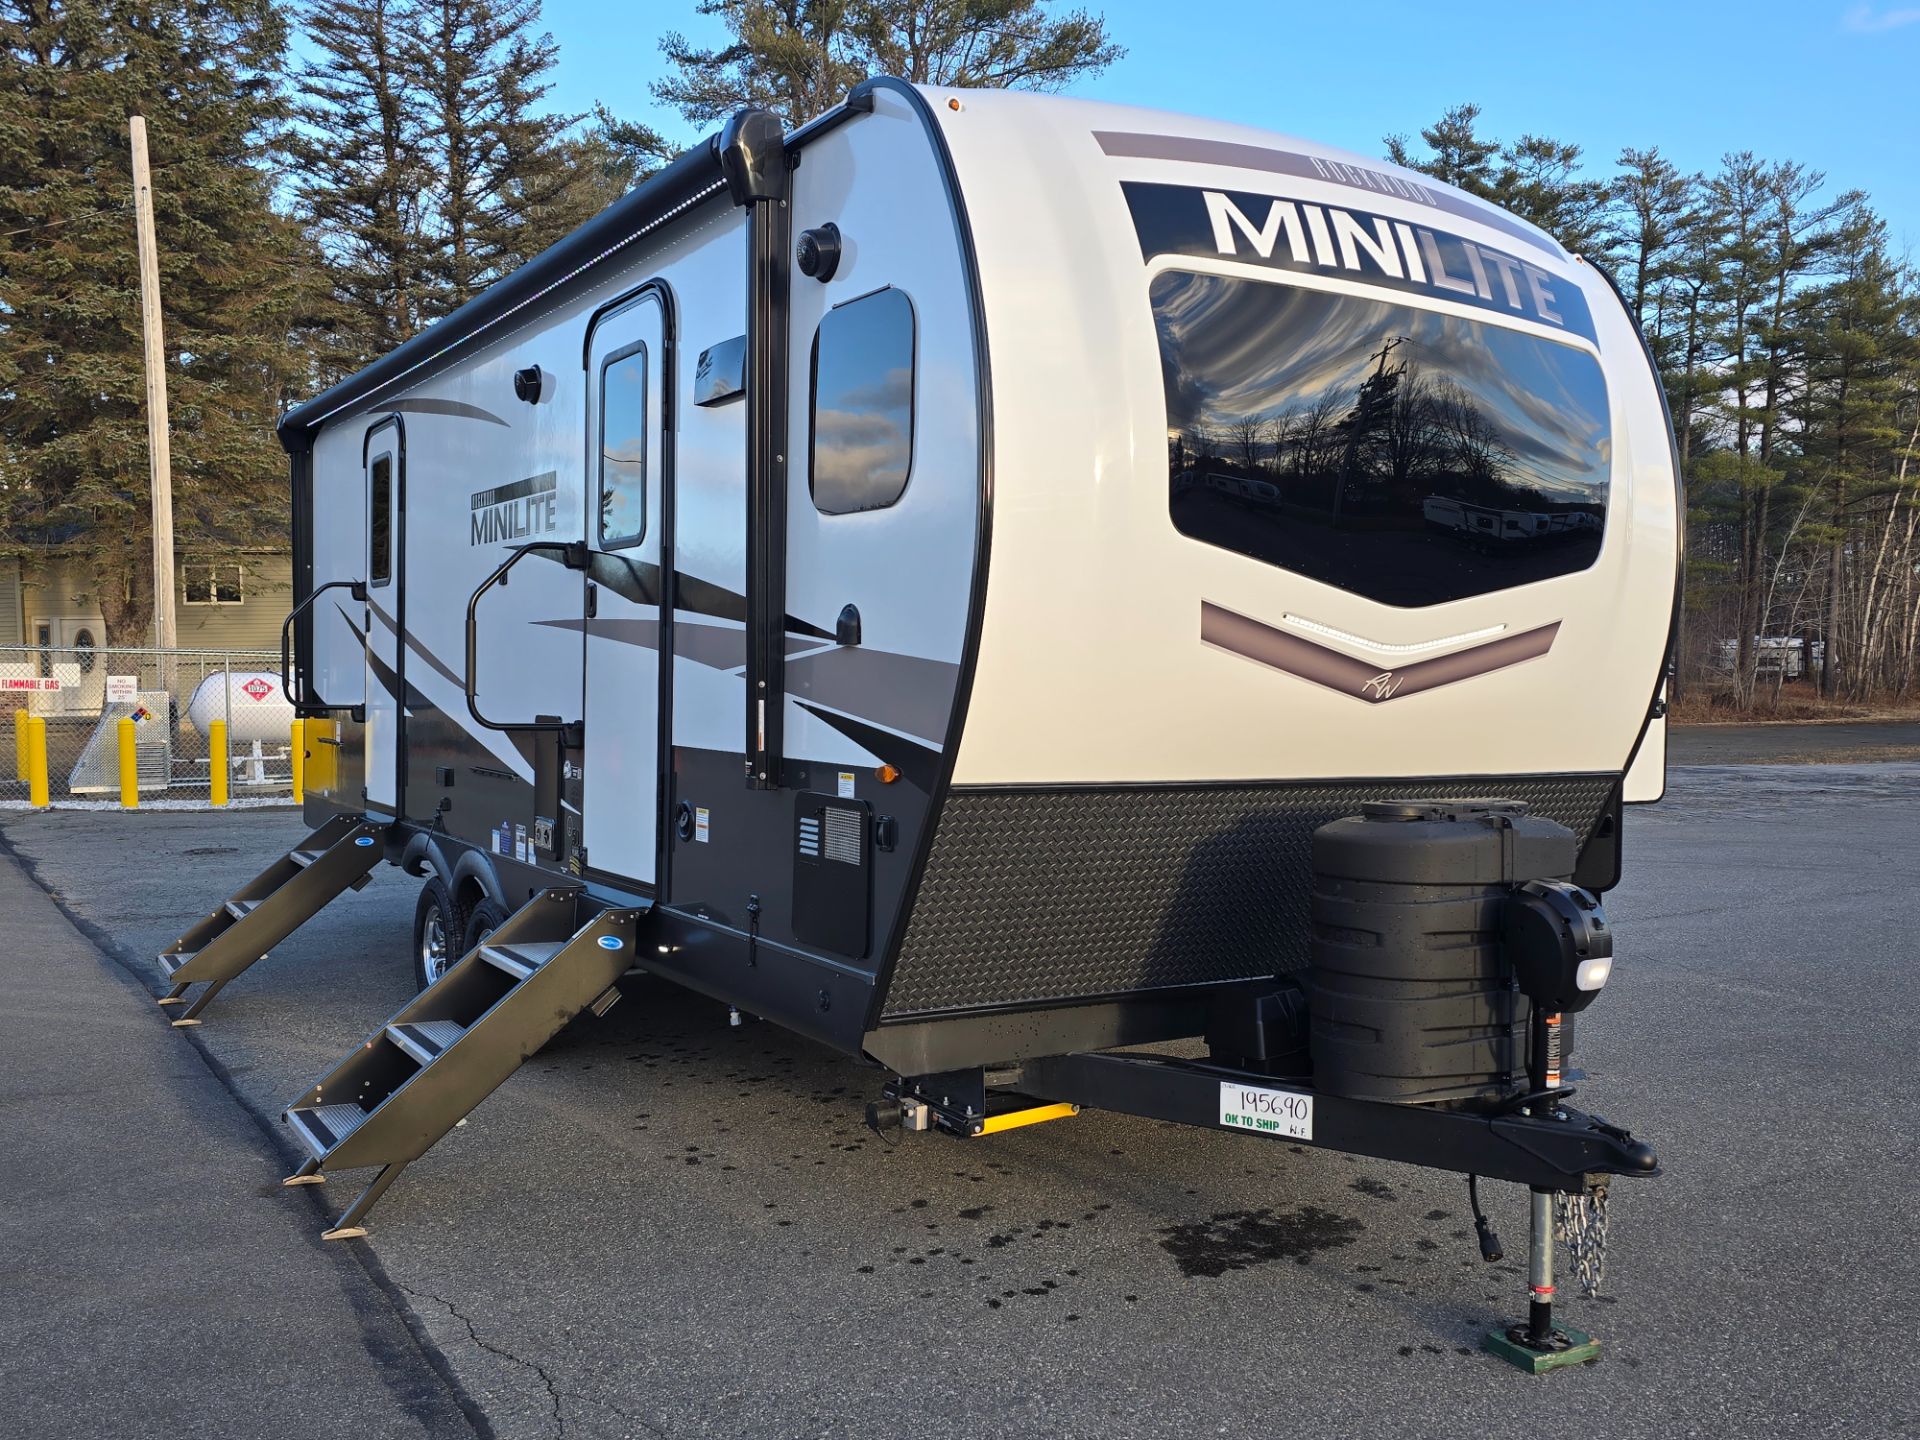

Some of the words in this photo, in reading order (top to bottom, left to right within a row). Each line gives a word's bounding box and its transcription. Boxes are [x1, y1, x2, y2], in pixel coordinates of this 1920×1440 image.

[1309, 156, 1437, 205] ROCKWOOD
[1202, 190, 1564, 326] MINILITE
[471, 491, 556, 546] MINILITE
[1, 680, 41, 690] FLAMMABLE
[44, 680, 60, 690] GAS
[1225, 1113, 1239, 1124] OK
[1241, 1115, 1253, 1127] TO
[1256, 1118, 1280, 1131] SHIP
[1241, 1091, 1308, 1120] 195690
